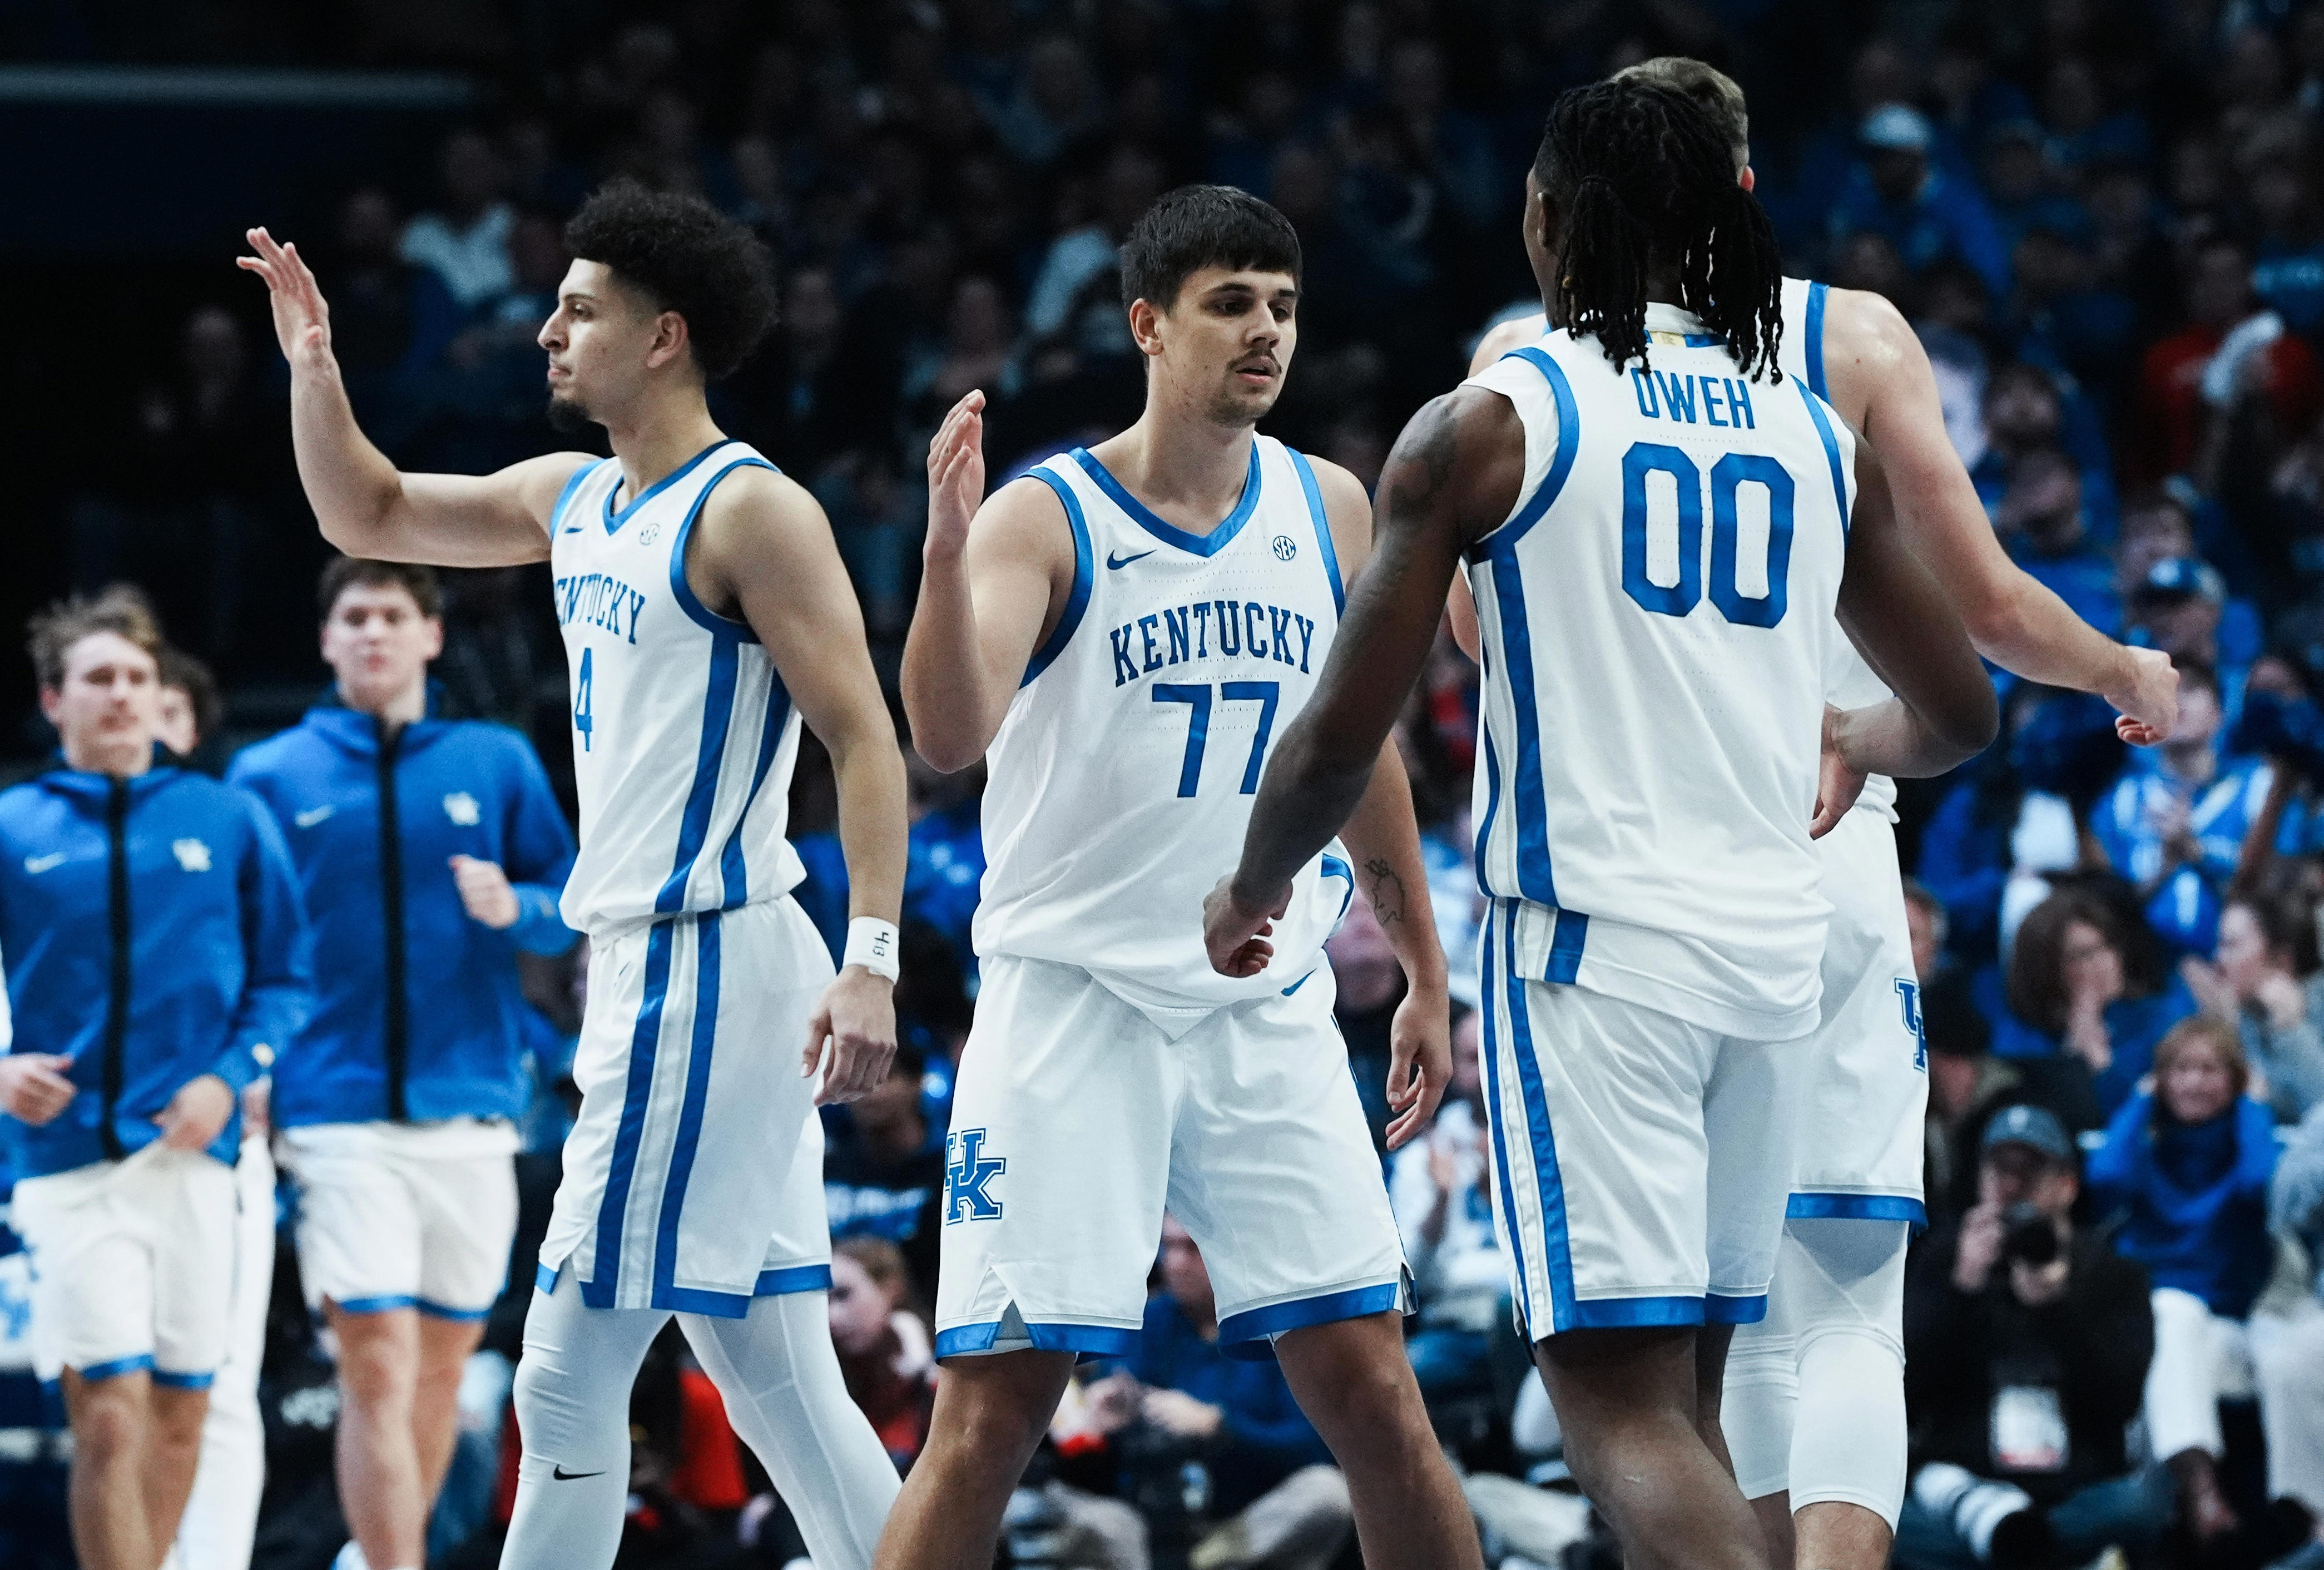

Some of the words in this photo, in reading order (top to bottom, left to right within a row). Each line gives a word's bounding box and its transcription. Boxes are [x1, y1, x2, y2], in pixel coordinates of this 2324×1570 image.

[1631, 367, 1756, 429] OWEH
[1273, 535, 1296, 561] SEC
[1622, 442, 1795, 629] 00
[555, 573, 645, 645] ENTUCKY
[1110, 600, 1314, 688] KENTUCKY
[574, 647, 593, 752] 4
[1152, 681, 1280, 798] 77
[945, 1127, 1007, 1226] UK
